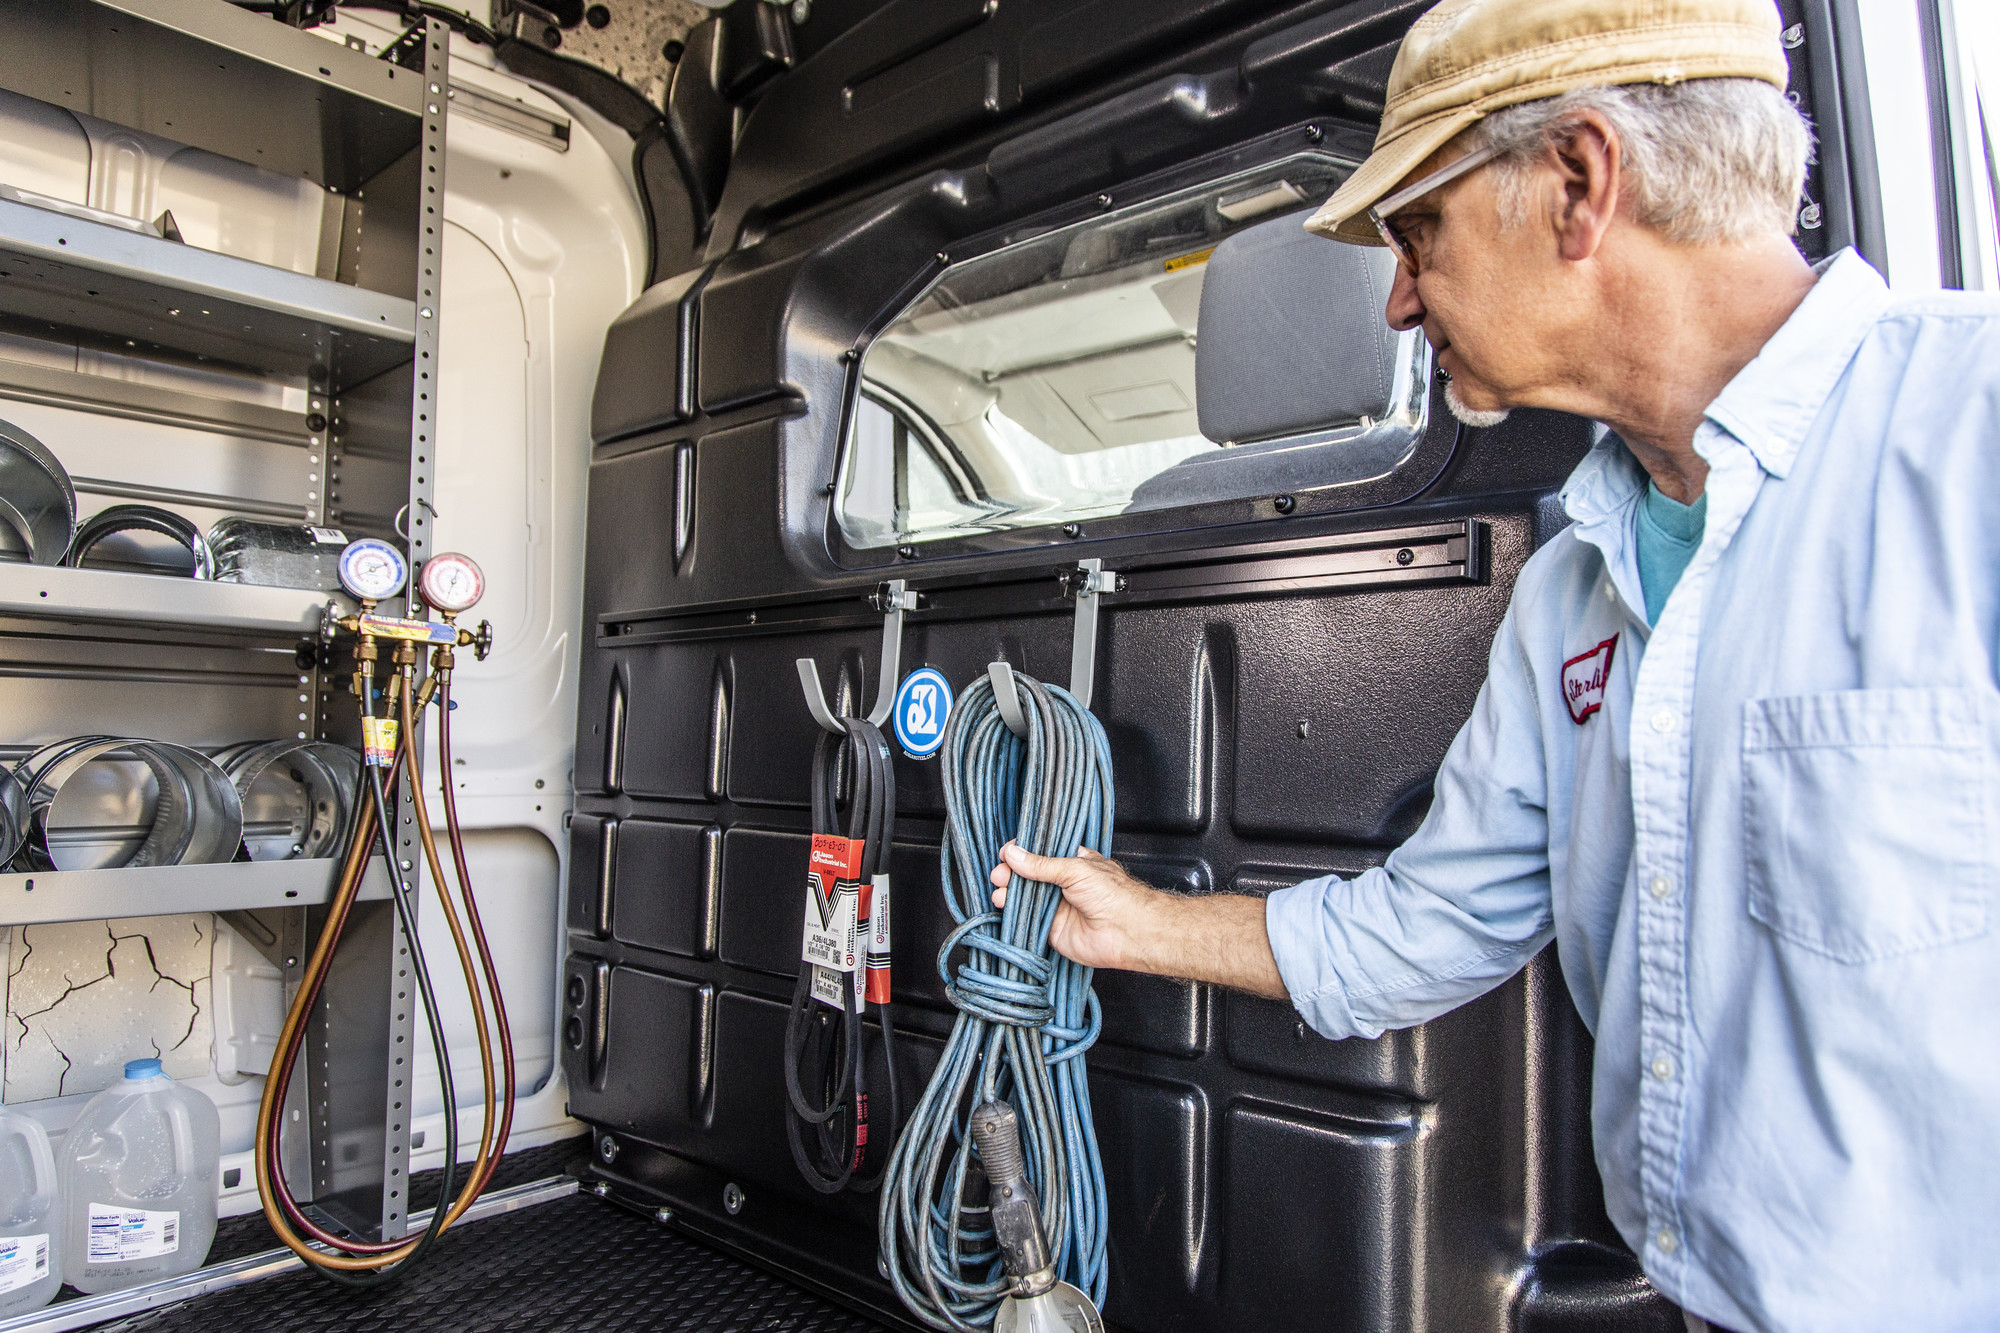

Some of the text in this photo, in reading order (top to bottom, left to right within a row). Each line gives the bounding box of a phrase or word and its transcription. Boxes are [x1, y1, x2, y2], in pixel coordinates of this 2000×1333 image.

[370, 615, 426, 627] YELLOW JACKET
[819, 851, 834, 860] Jason
[818, 858, 840, 867] Industrial
[812, 934, 837, 949] A36/4L380
